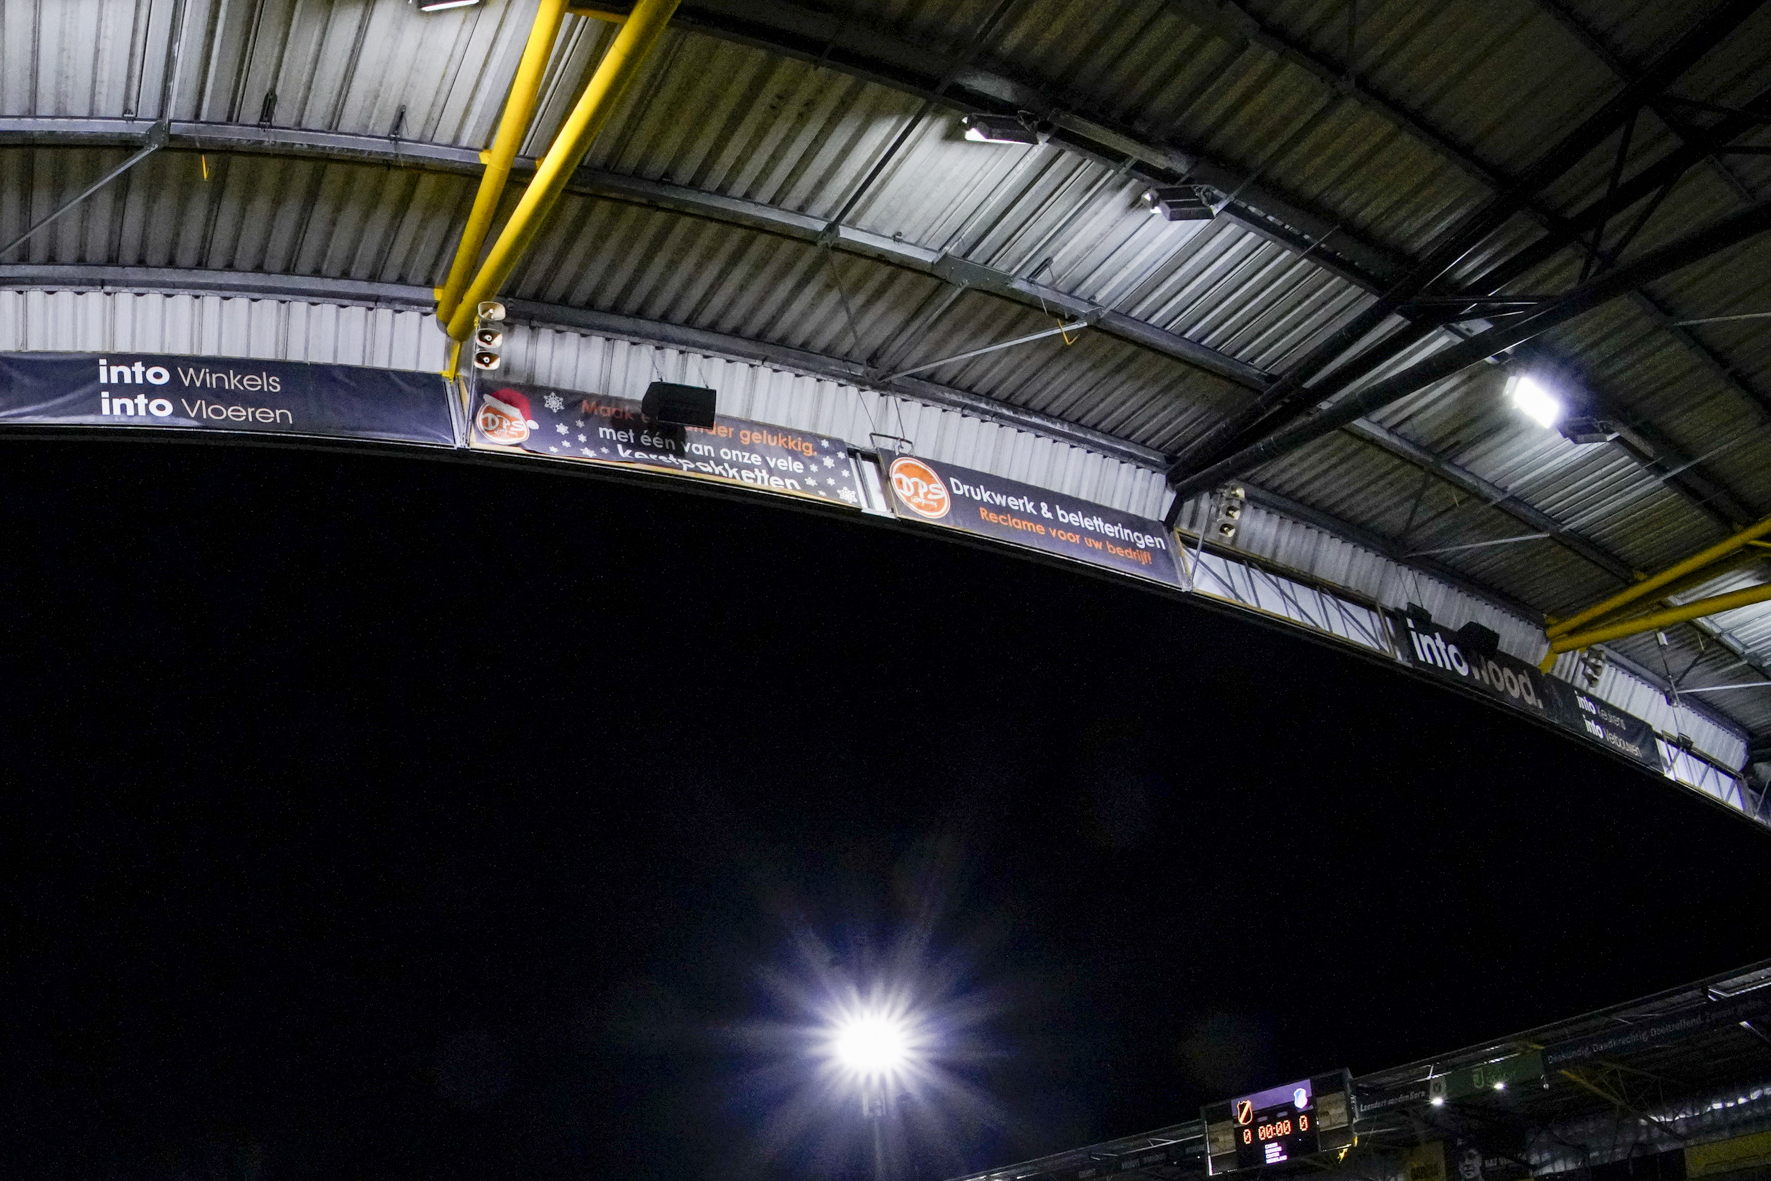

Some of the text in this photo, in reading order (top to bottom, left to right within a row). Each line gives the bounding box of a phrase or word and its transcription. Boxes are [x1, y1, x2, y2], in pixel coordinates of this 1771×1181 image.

[98, 359, 281, 394] into Winkels
[100, 390, 294, 425] into Vloeren
[599, 425, 804, 474] met één van onze vele
[740, 426, 818, 456] gelukkig.
[949, 476, 1167, 551] Drukwerk & beletteringen
[978, 506, 1104, 548] Reclame voor uw
[1242, 1114, 1309, 1146] 0 00:00 0
